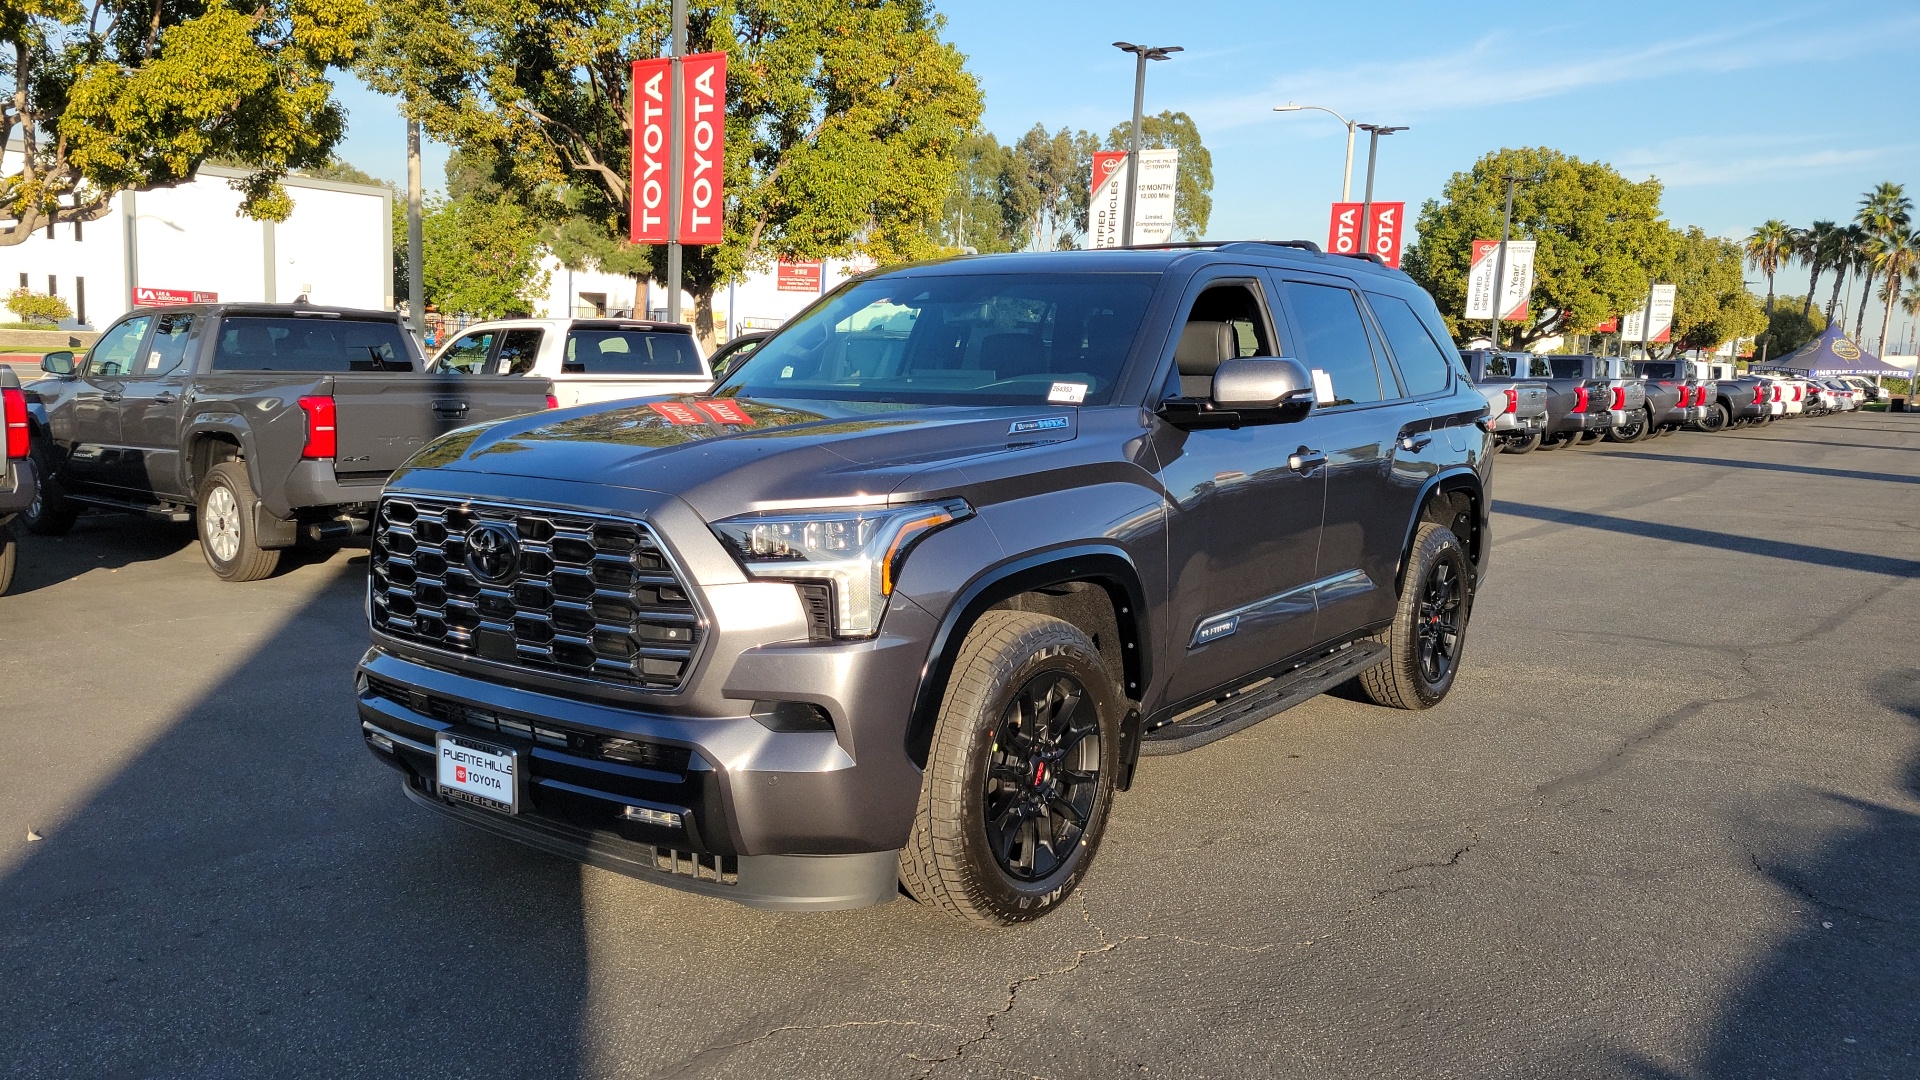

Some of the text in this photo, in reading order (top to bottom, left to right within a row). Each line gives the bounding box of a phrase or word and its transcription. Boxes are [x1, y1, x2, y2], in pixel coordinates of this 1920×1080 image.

[643, 71, 663, 233] TOYOTA
[692, 66, 715, 233] TOYOTA
[1096, 210, 1106, 249] RTIFIED
[1107, 181, 1119, 248] ED VEHICLES
[1336, 208, 1356, 253] OTA
[1376, 207, 1395, 262] YOTA
[1483, 258, 1493, 292] VEHICLES
[1511, 263, 1520, 288] Year/
[1473, 276, 1483, 311] CERTIFIED
[1790, 367, 1808, 376] OFFER
[1815, 369, 1857, 377] INSTANT
[1881, 370, 1910, 378] OFFER
[443, 748, 513, 775] PUENTE HILLS
[468, 772, 501, 790] TOYOTA
[441, 786, 510, 813] PUENTE HILLS
